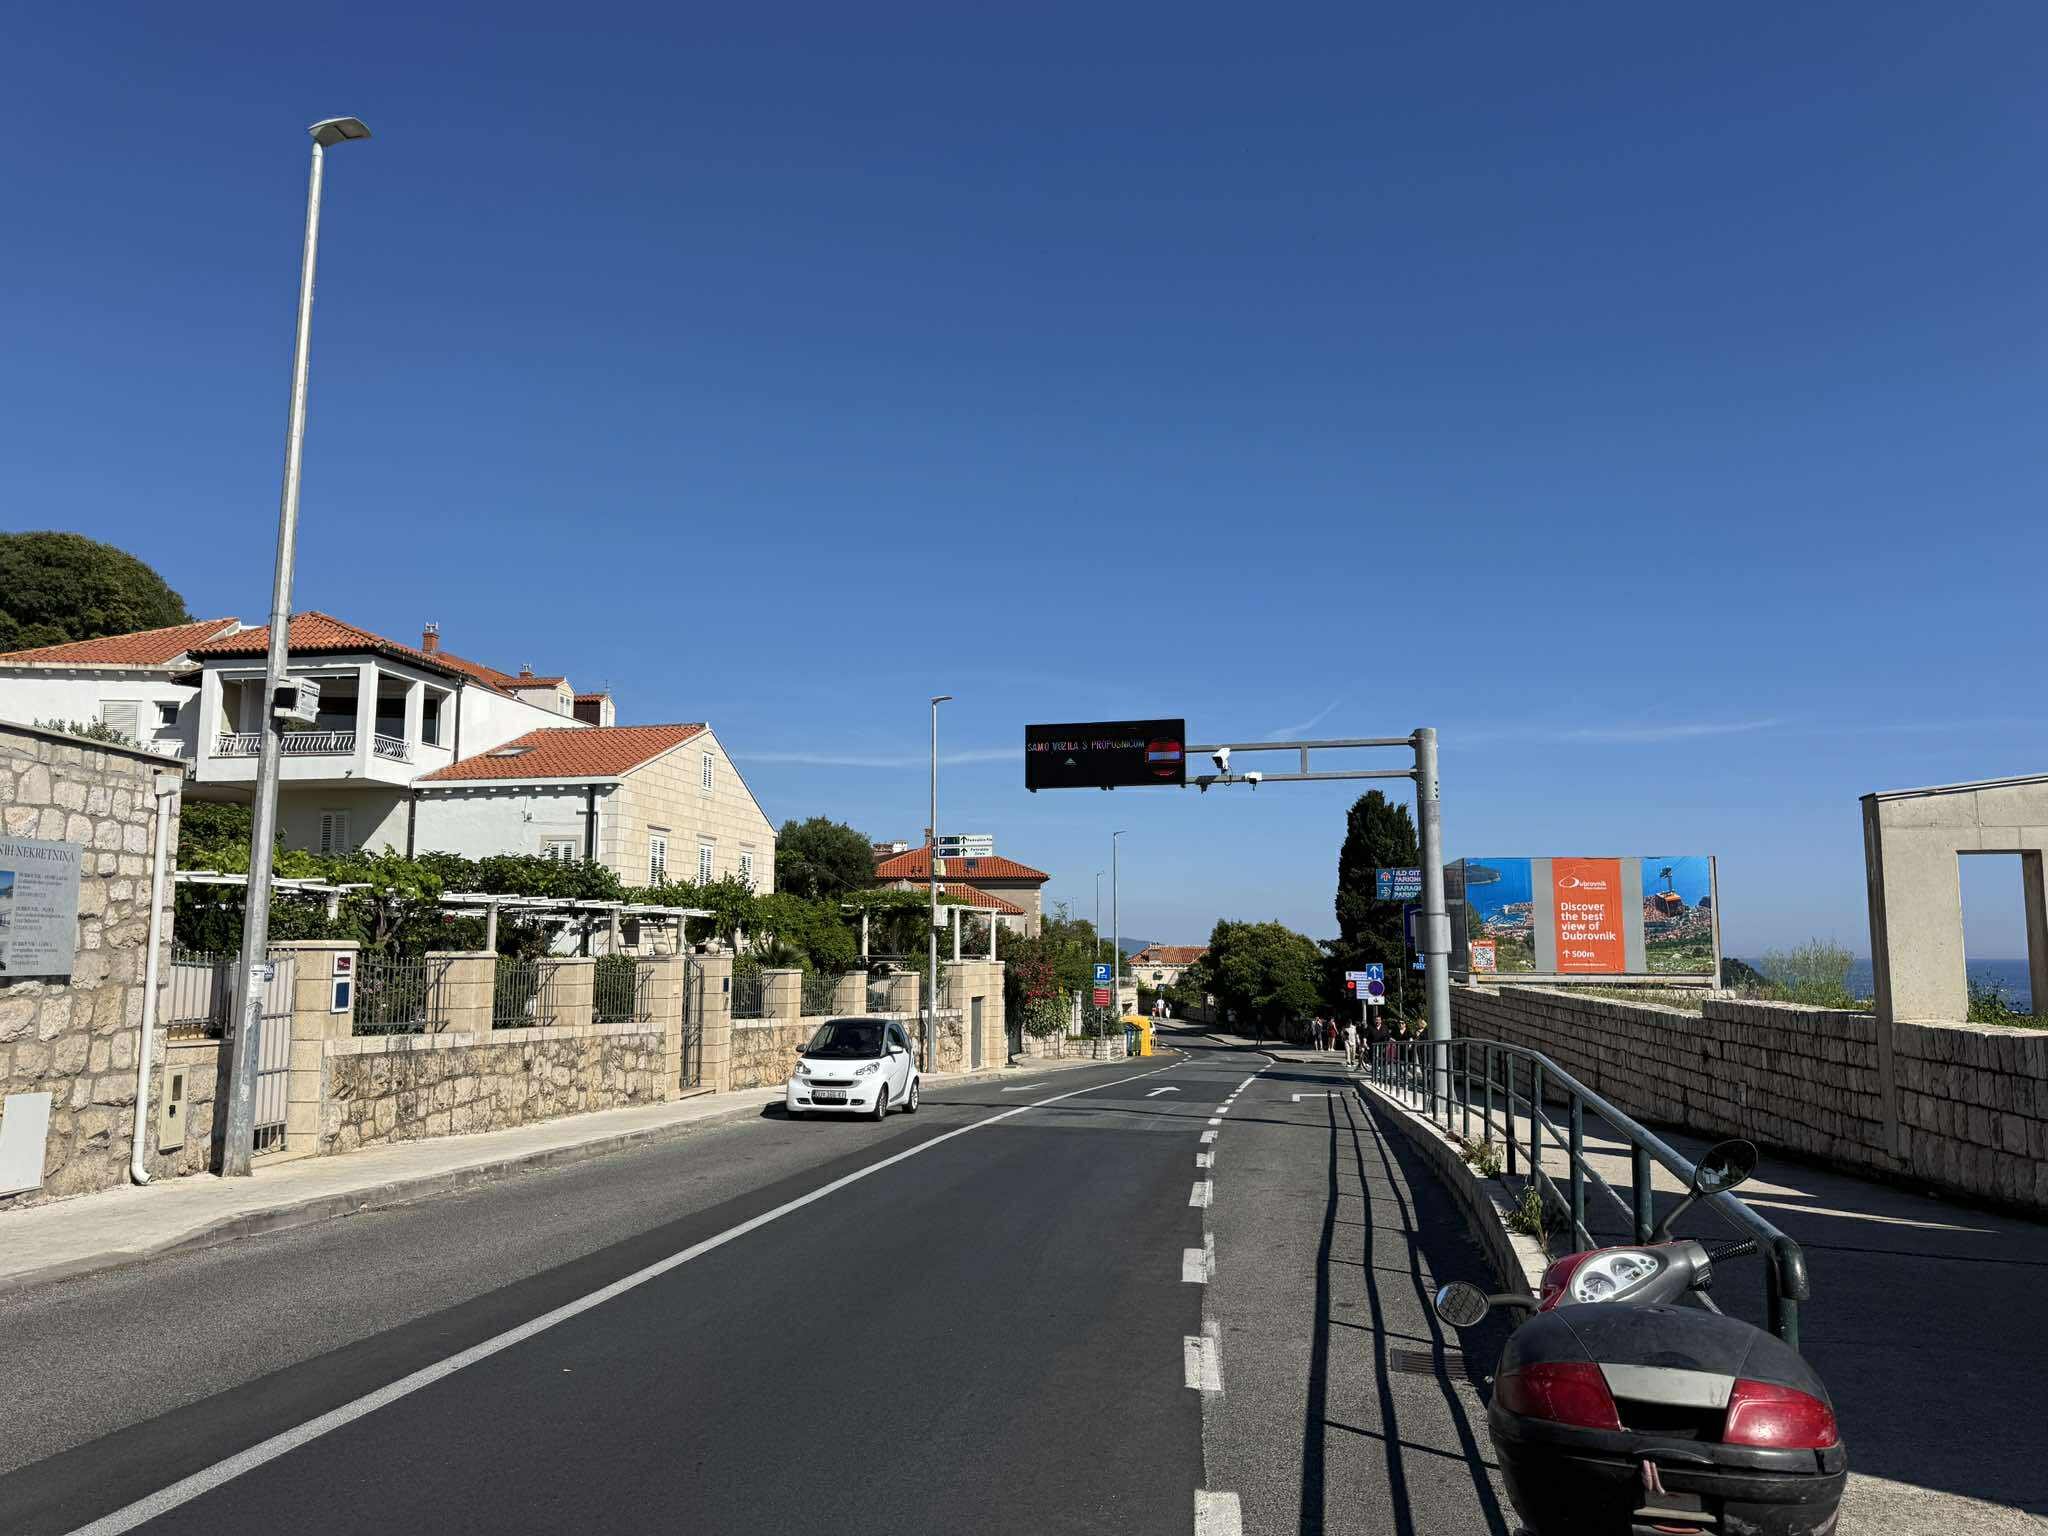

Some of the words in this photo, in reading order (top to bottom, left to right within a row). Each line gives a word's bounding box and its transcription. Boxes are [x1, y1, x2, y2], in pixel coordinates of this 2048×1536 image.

[1027, 742, 1049, 752] SAMO
[16, 845, 76, 863] NEKRETNINA
[1561, 902, 1605, 911] Discover
[1561, 912, 1578, 921] the
[1581, 912, 1604, 921] best
[1561, 922, 1585, 930] view
[1588, 921, 1600, 930] of
[1562, 932, 1616, 941] Dubrovnik
[1572, 950, 1595, 958] 500m
[1097, 966, 1106, 979] P
